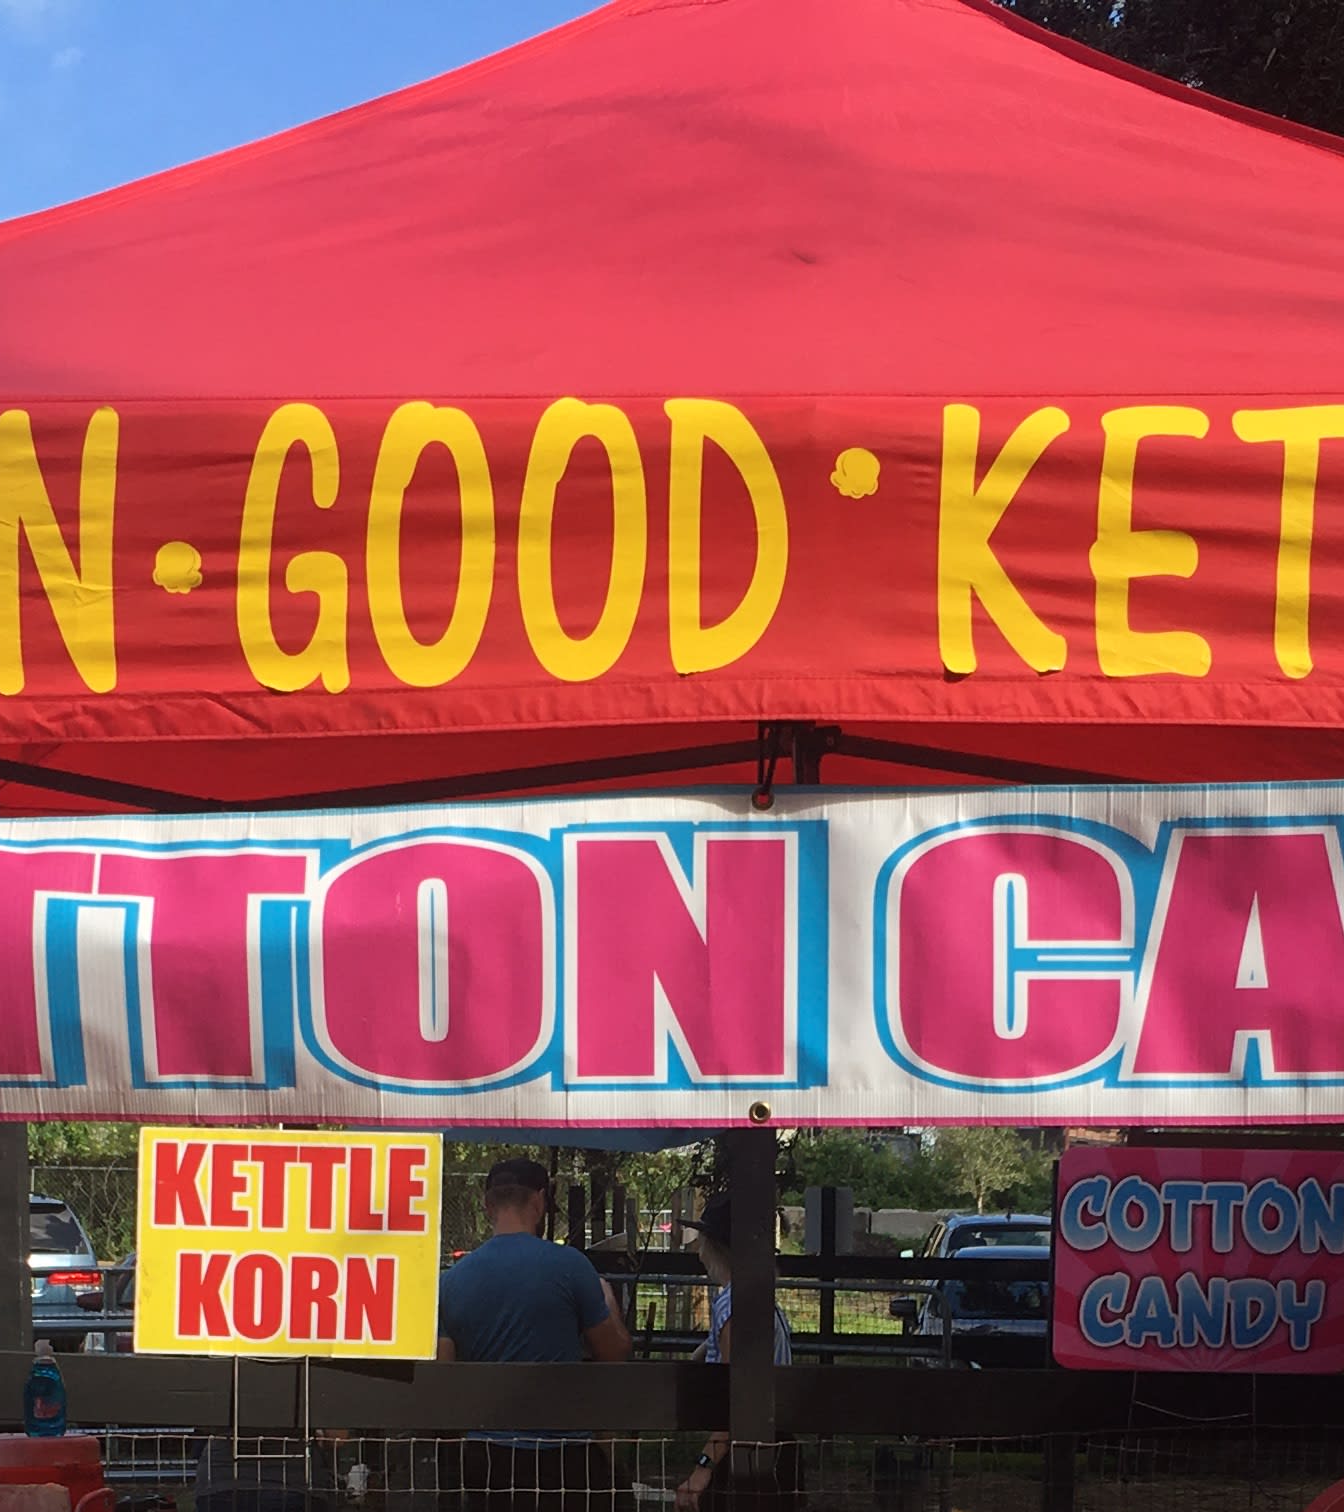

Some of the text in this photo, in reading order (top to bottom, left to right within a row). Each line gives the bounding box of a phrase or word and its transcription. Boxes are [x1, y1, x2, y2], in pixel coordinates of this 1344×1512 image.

[236, 397, 788, 694] GOOD
[152, 1141, 428, 1232] KETTLE
[176, 1253, 397, 1345] KORN
[1079, 1271, 1327, 1351] CANDY
